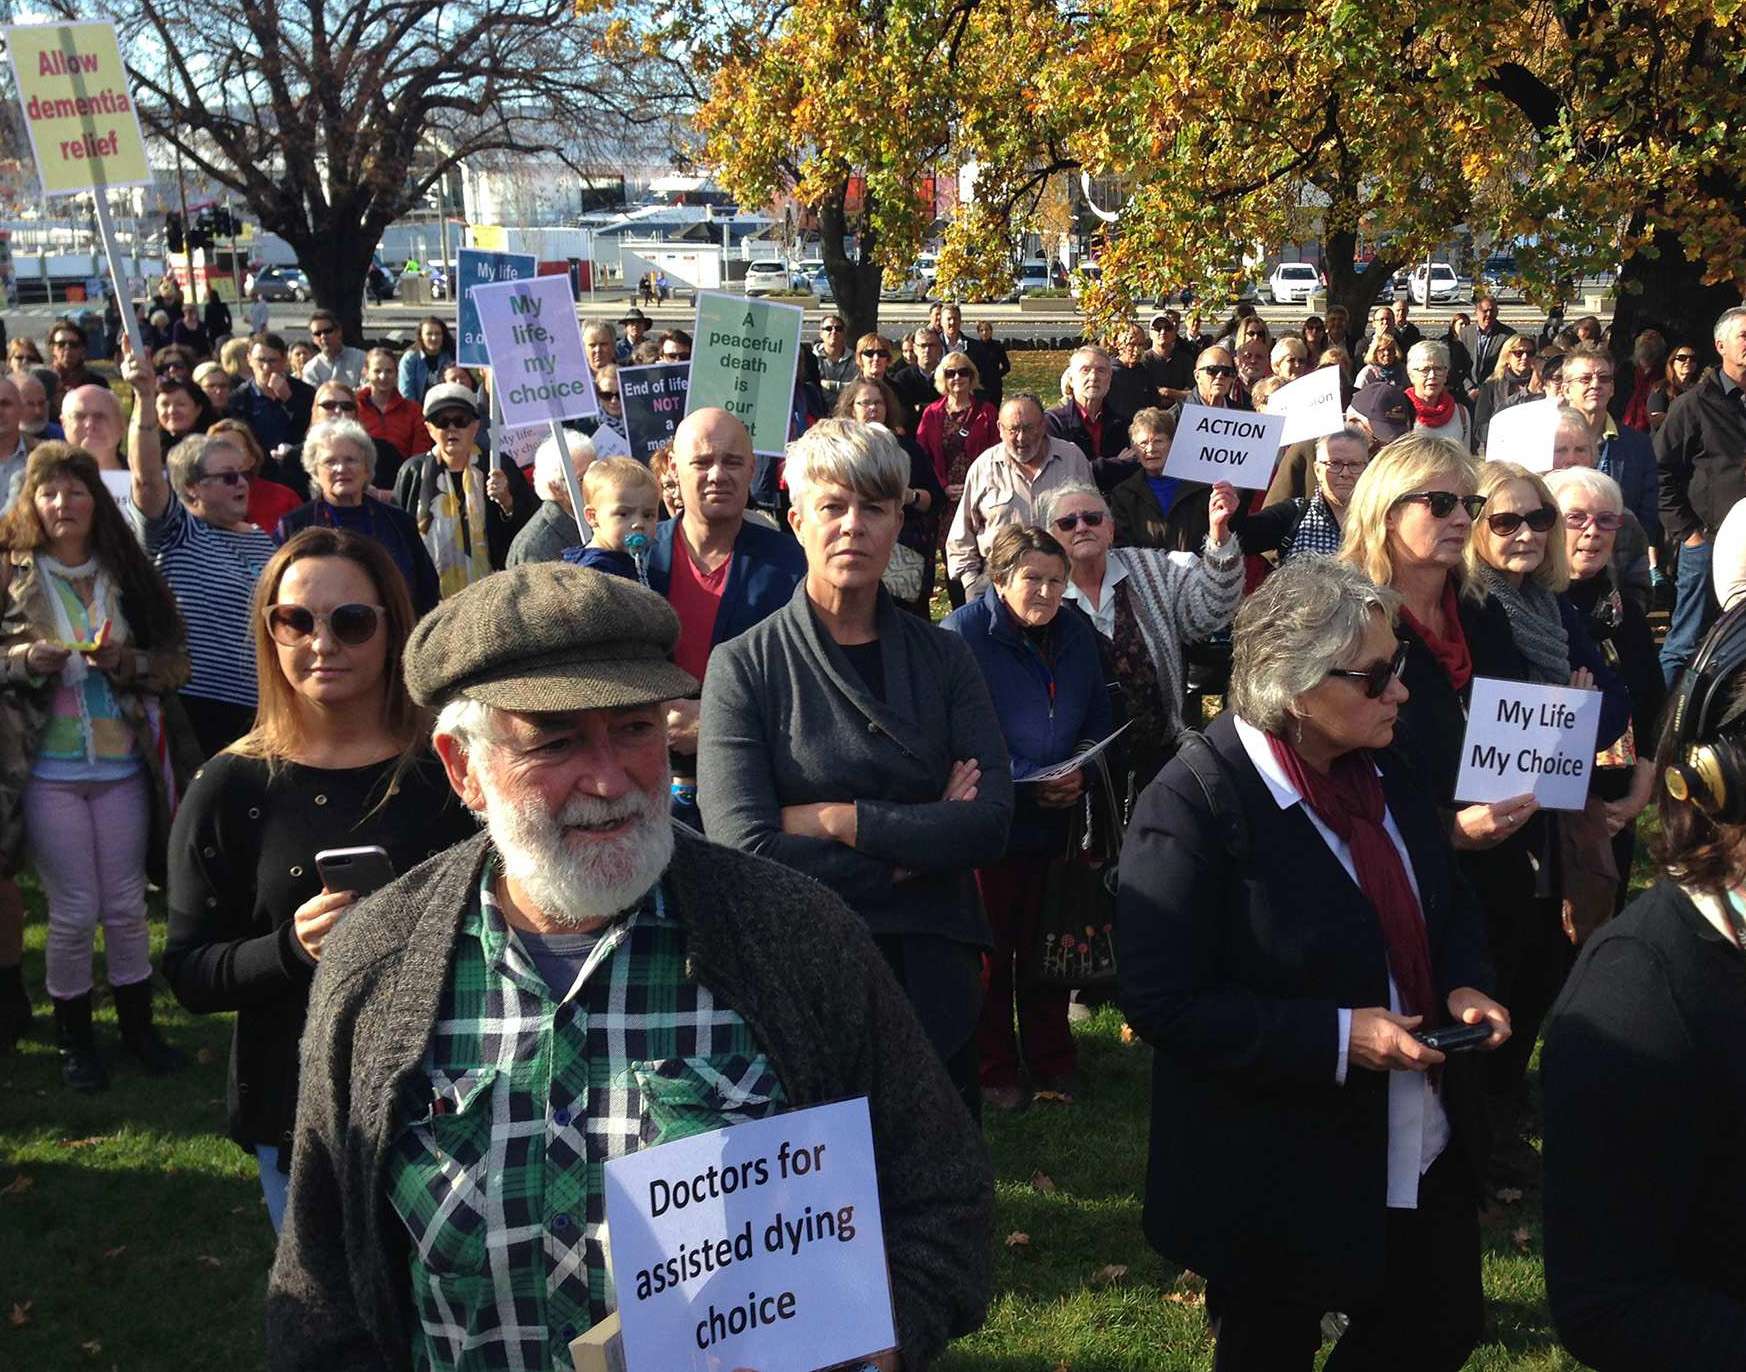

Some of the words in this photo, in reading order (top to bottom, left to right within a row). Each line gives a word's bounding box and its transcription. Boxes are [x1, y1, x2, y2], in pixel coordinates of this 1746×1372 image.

[38, 50, 98, 76] Allow
[27, 88, 130, 120] dementia
[60, 129, 118, 160] relief
[477, 262, 496, 281] My
[499, 264, 518, 280] life
[509, 294, 542, 318] My
[742, 312, 755, 328] A
[512, 323, 554, 344] life,
[709, 332, 783, 354] peaceful
[524, 354, 556, 375] my
[720, 353, 767, 373] death
[509, 380, 585, 405] choice
[624, 381, 649, 397] End
[652, 379, 665, 393] of
[668, 377, 689, 392] life
[734, 376, 748, 392] is
[652, 397, 680, 412] NOT
[724, 400, 753, 414] our
[665, 419, 674, 430] a
[1196, 417, 1266, 439] ACTION
[1199, 446, 1249, 465] NOW
[1496, 699, 1534, 730] My
[1539, 703, 1575, 729] Life
[1471, 744, 1510, 776] My
[1517, 749, 1584, 777] Choice
[649, 1157, 769, 1218] Doctors
[778, 1142, 825, 1179] for
[636, 1221, 753, 1300] assisted
[764, 1206, 856, 1256] dying
[696, 1291, 796, 1350] choice
